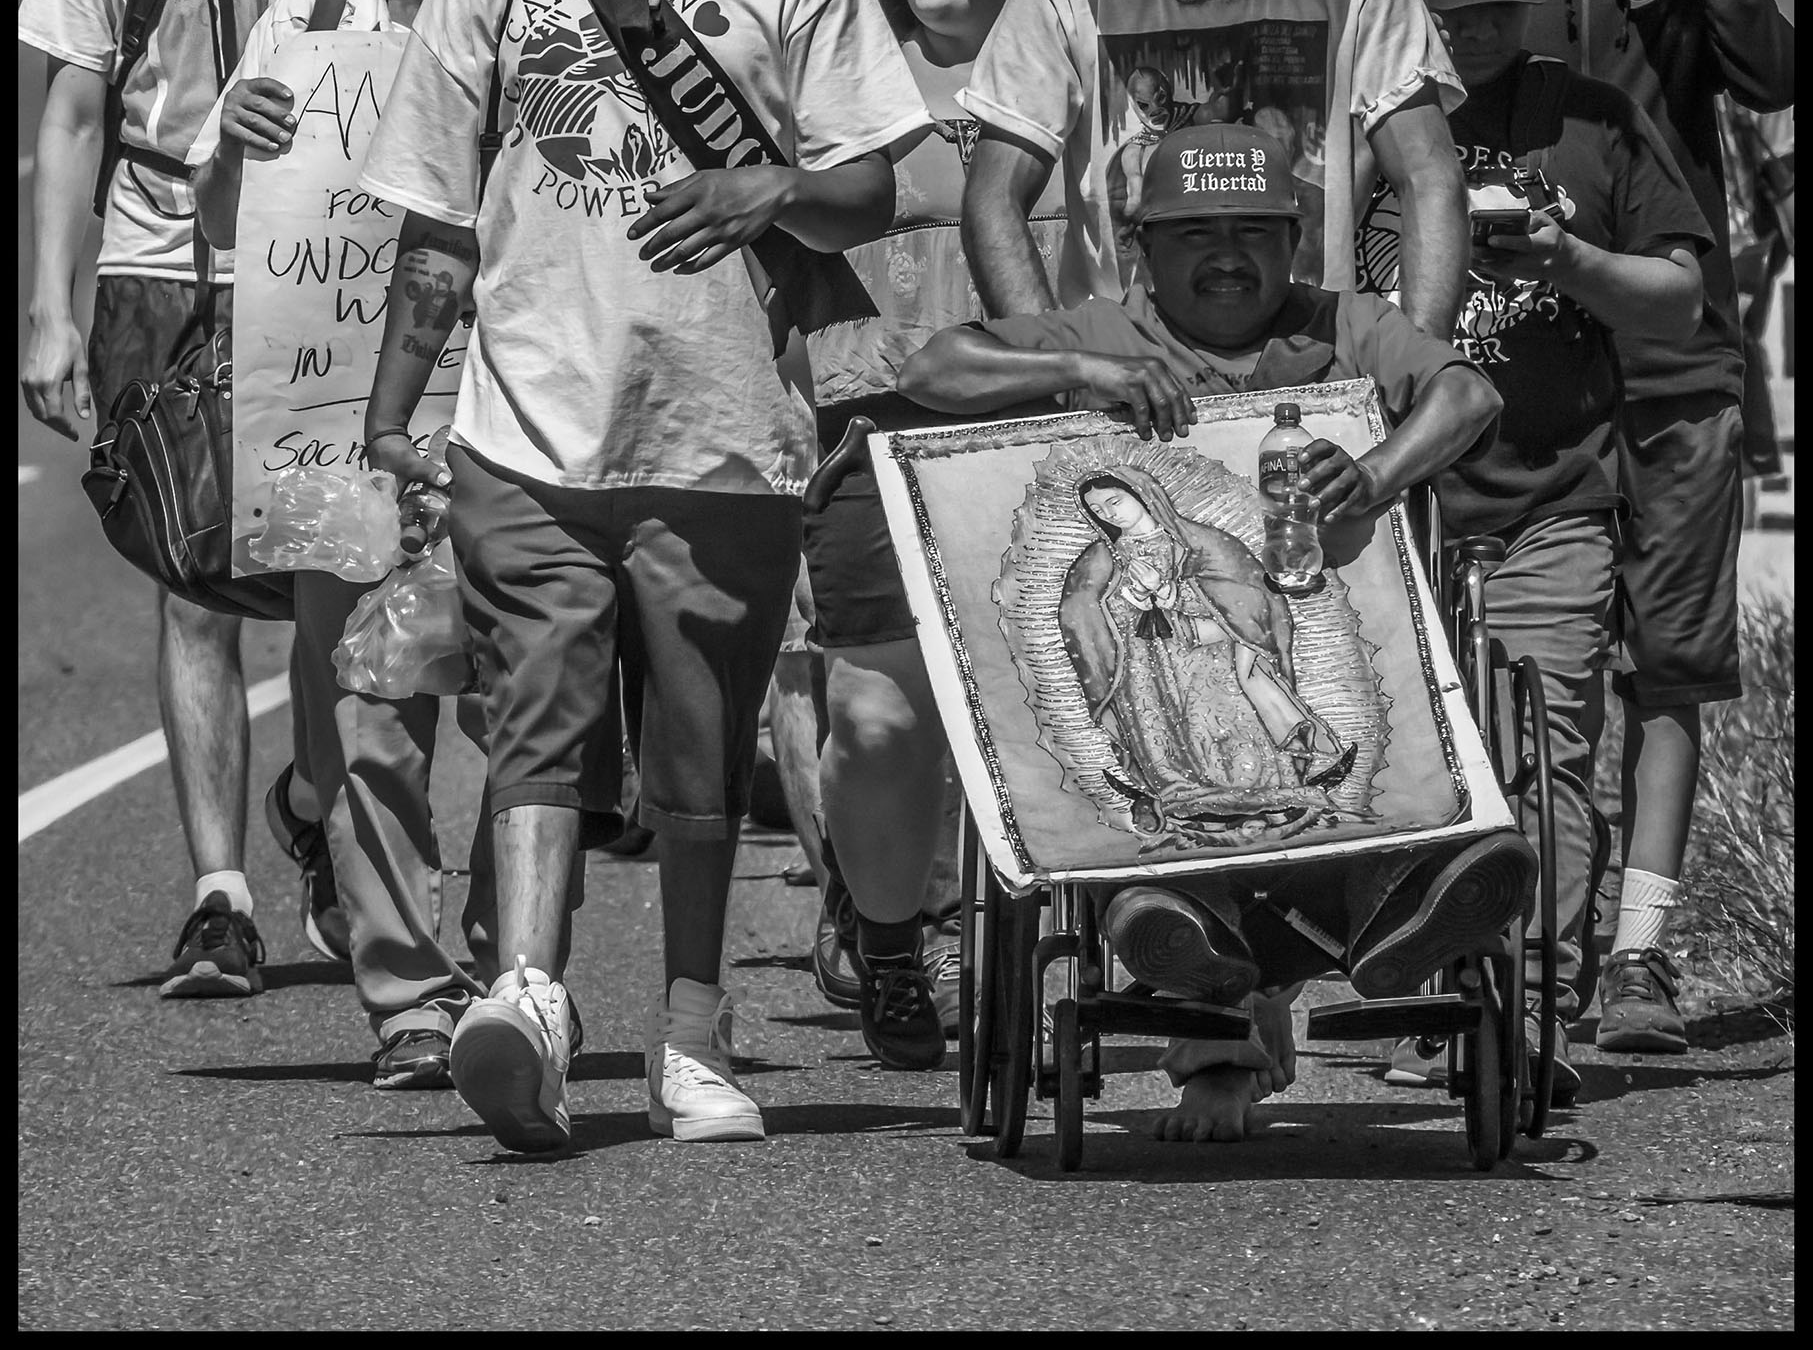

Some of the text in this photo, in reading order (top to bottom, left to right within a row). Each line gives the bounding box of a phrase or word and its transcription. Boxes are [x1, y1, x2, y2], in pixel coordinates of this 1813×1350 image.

[1180, 148, 1247, 170] Tierra
[1182, 172, 1267, 194] Libertad
[290, 341, 332, 384] IN
